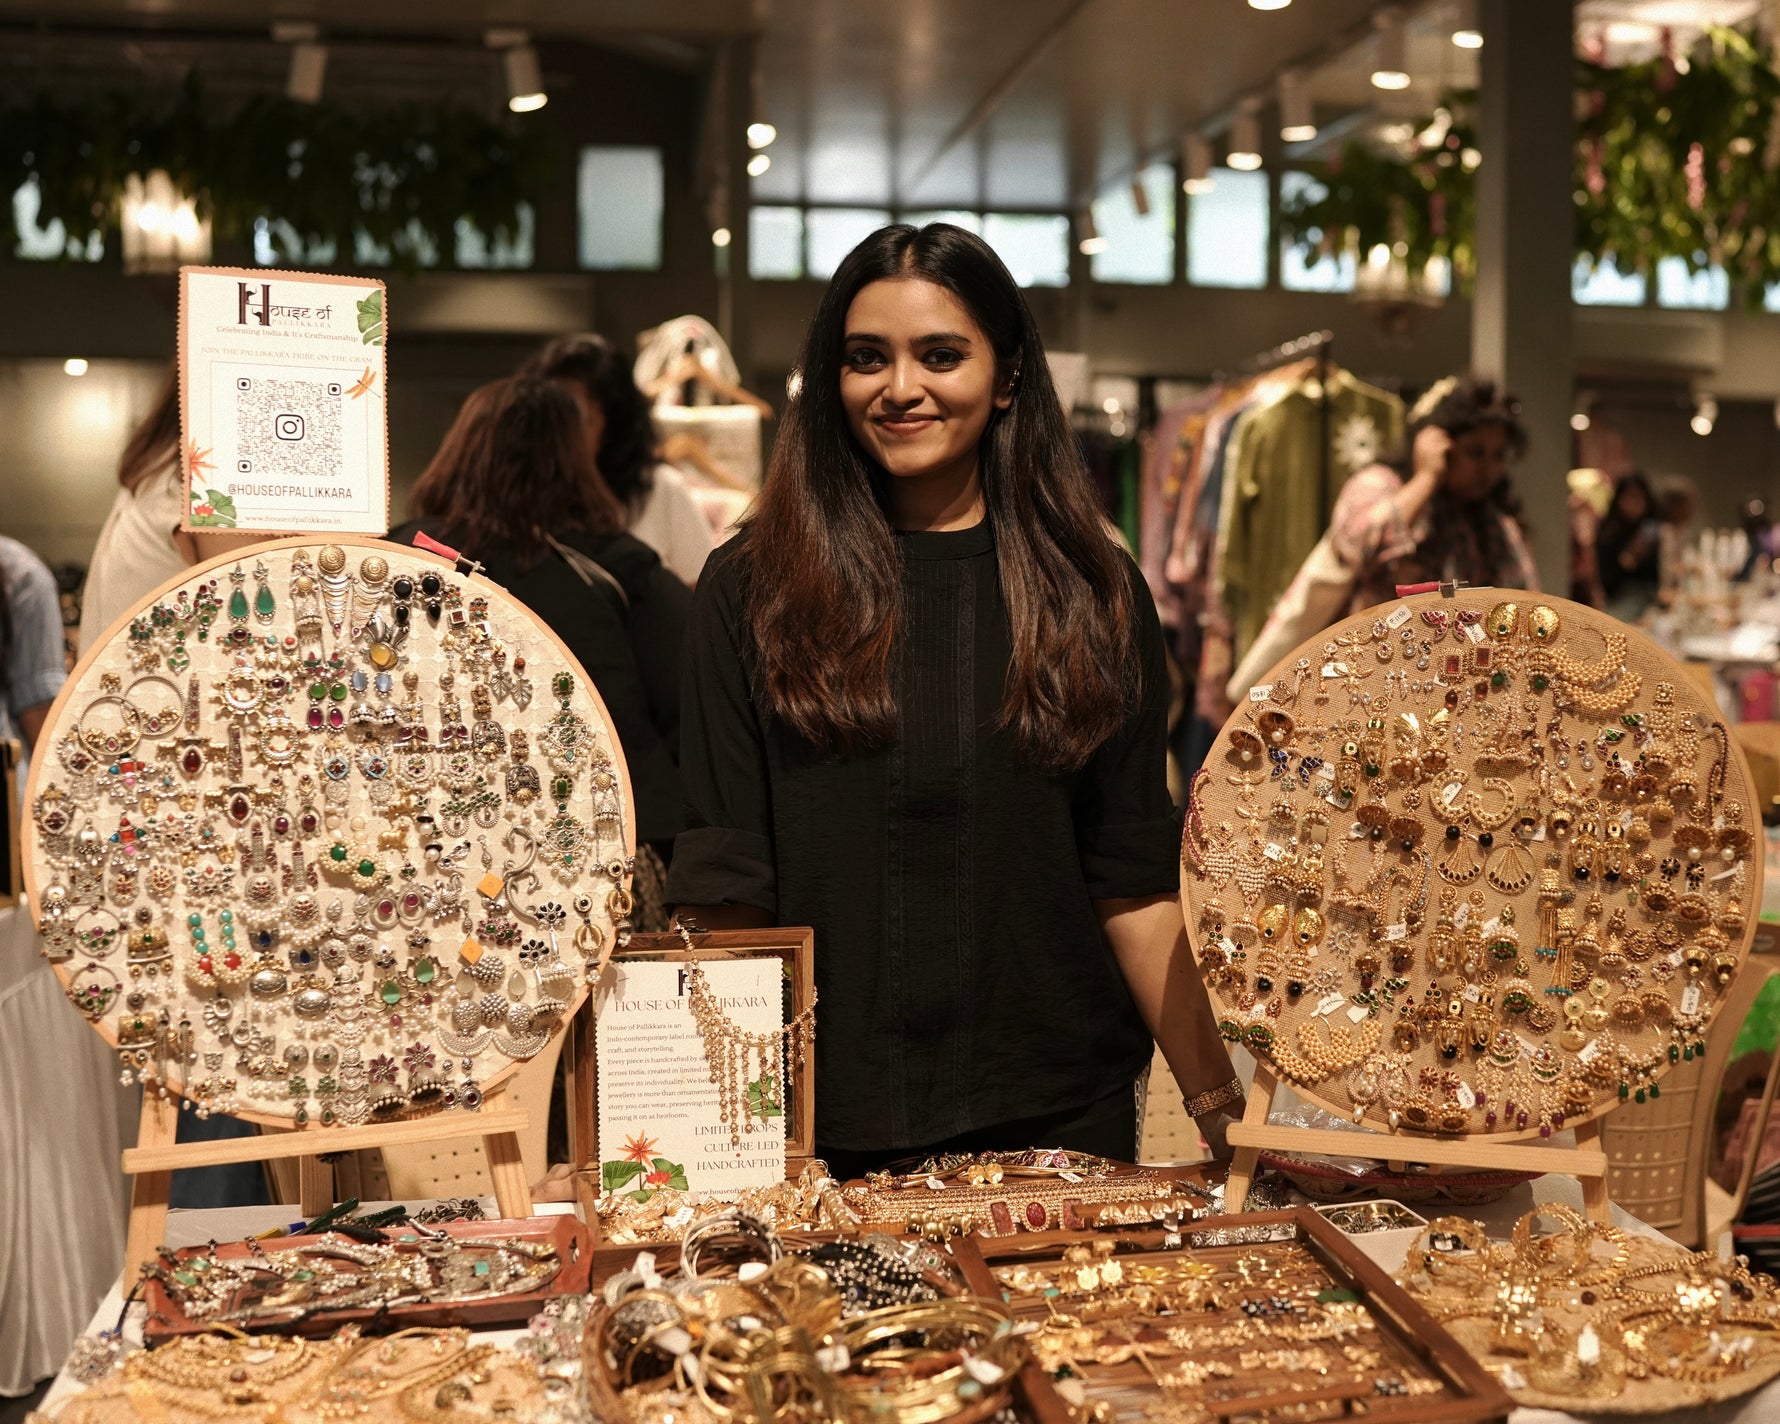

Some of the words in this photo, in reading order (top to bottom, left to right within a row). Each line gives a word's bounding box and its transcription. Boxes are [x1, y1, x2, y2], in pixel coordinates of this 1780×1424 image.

[316, 305, 333, 320] of
[271, 319, 331, 329] PALLIKKARA
[216, 326, 261, 337] Celebrating
[262, 329, 282, 337] India
[304, 332, 358, 343] Craftsmanship
[240, 350, 290, 359] PALLIKKARA
[292, 352, 315, 360] TRIBE
[349, 356, 372, 364] GRAM
[228, 484, 353, 499] @HOUSEOFPALLIKKARA
[245, 515, 342, 525] www.houseofpallikkara.in
[615, 1000, 662, 1012] HOUSE
[665, 999, 685, 1010] OF
[607, 1034, 668, 1043] Indo-contemporary
[608, 1092, 636, 1100] jewellery
[669, 1101, 703, 1109] preserving
[608, 1115, 632, 1123] passing
[695, 1125, 734, 1136] LIMITE
[697, 1159, 780, 1171] HANDCRAFTED
